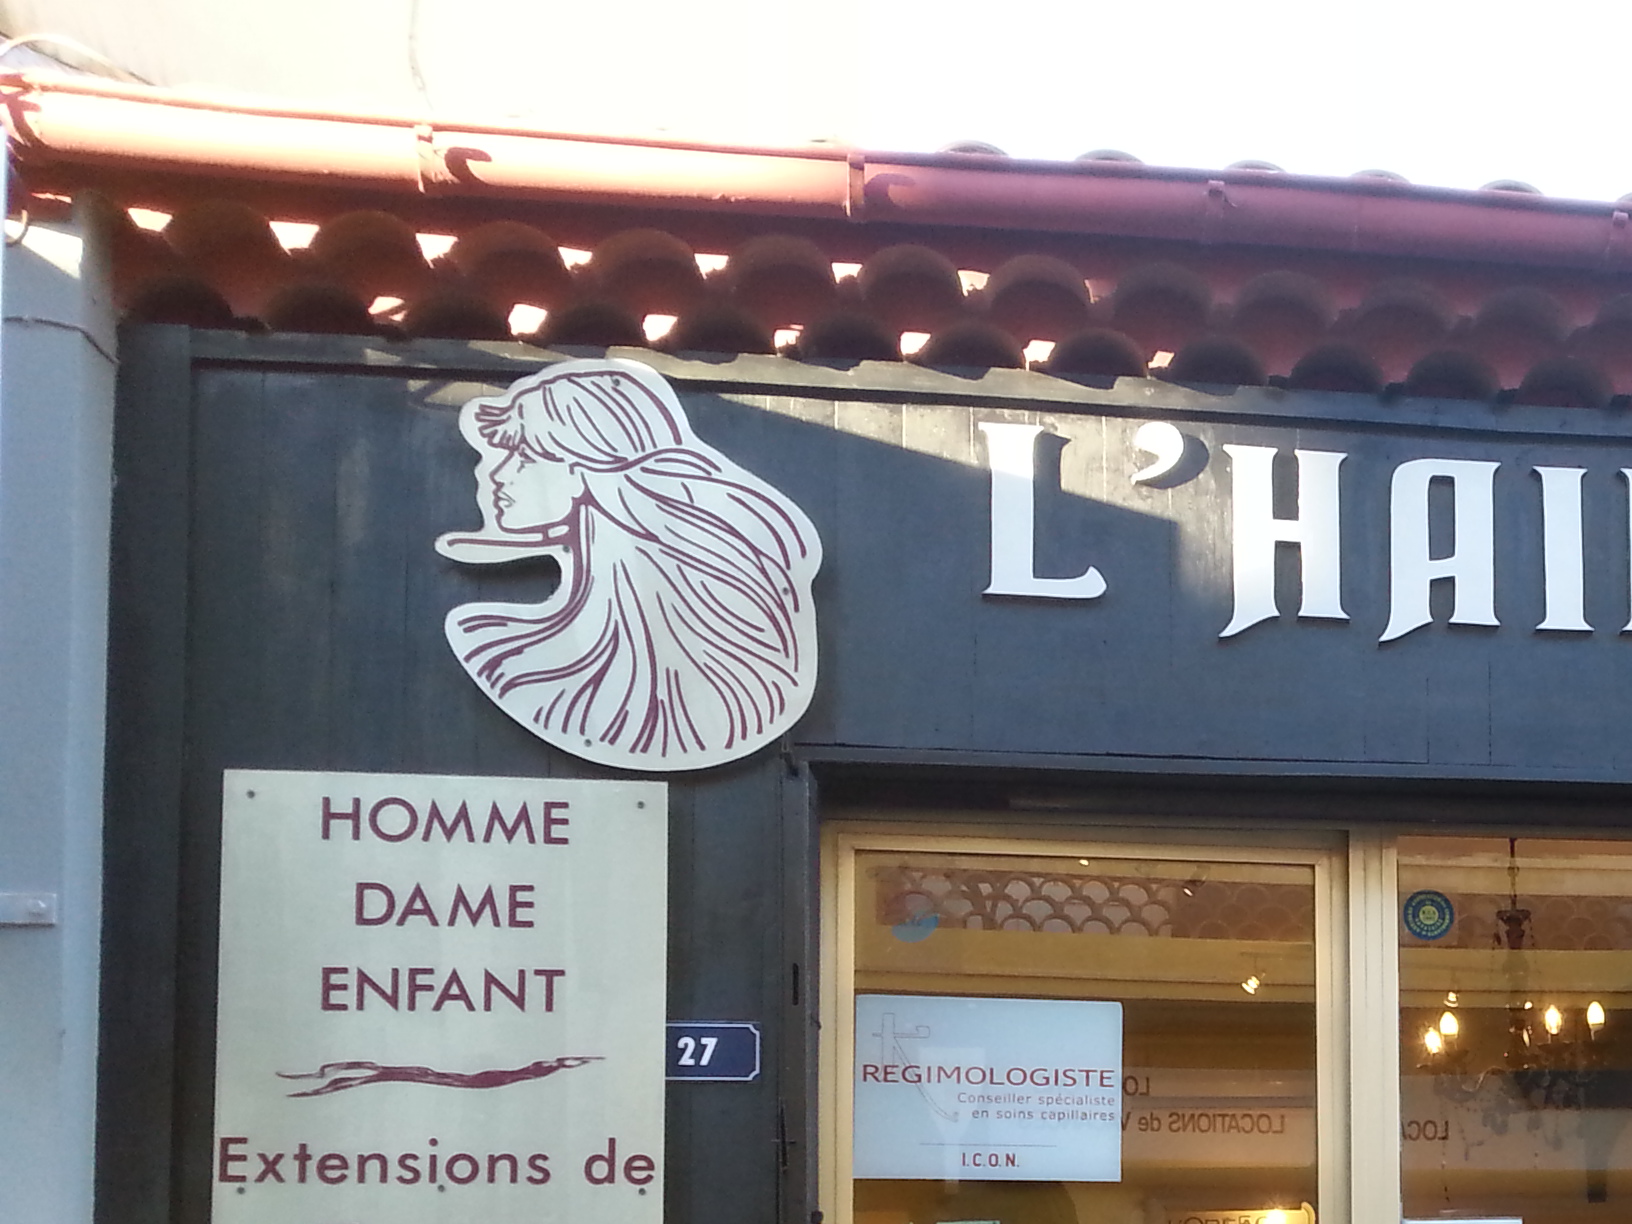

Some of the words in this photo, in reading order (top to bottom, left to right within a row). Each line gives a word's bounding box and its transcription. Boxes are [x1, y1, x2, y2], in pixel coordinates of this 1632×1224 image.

[320, 796, 570, 845] HOMME
[354, 882, 535, 928] DAME
[320, 967, 566, 1012] ENFANT
[677, 1037, 719, 1067] 27
[862, 1063, 1116, 1088] REGIMOLOGISTE
[957, 1092, 1032, 1105] Conseiller
[1038, 1093, 1116, 1107] spécialiste
[971, 1110, 989, 1119] en
[996, 1108, 1034, 1120] soins
[1041, 1109, 1116, 1122] capillaires
[218, 1136, 552, 1186] Extensions
[584, 1137, 656, 1185] de
